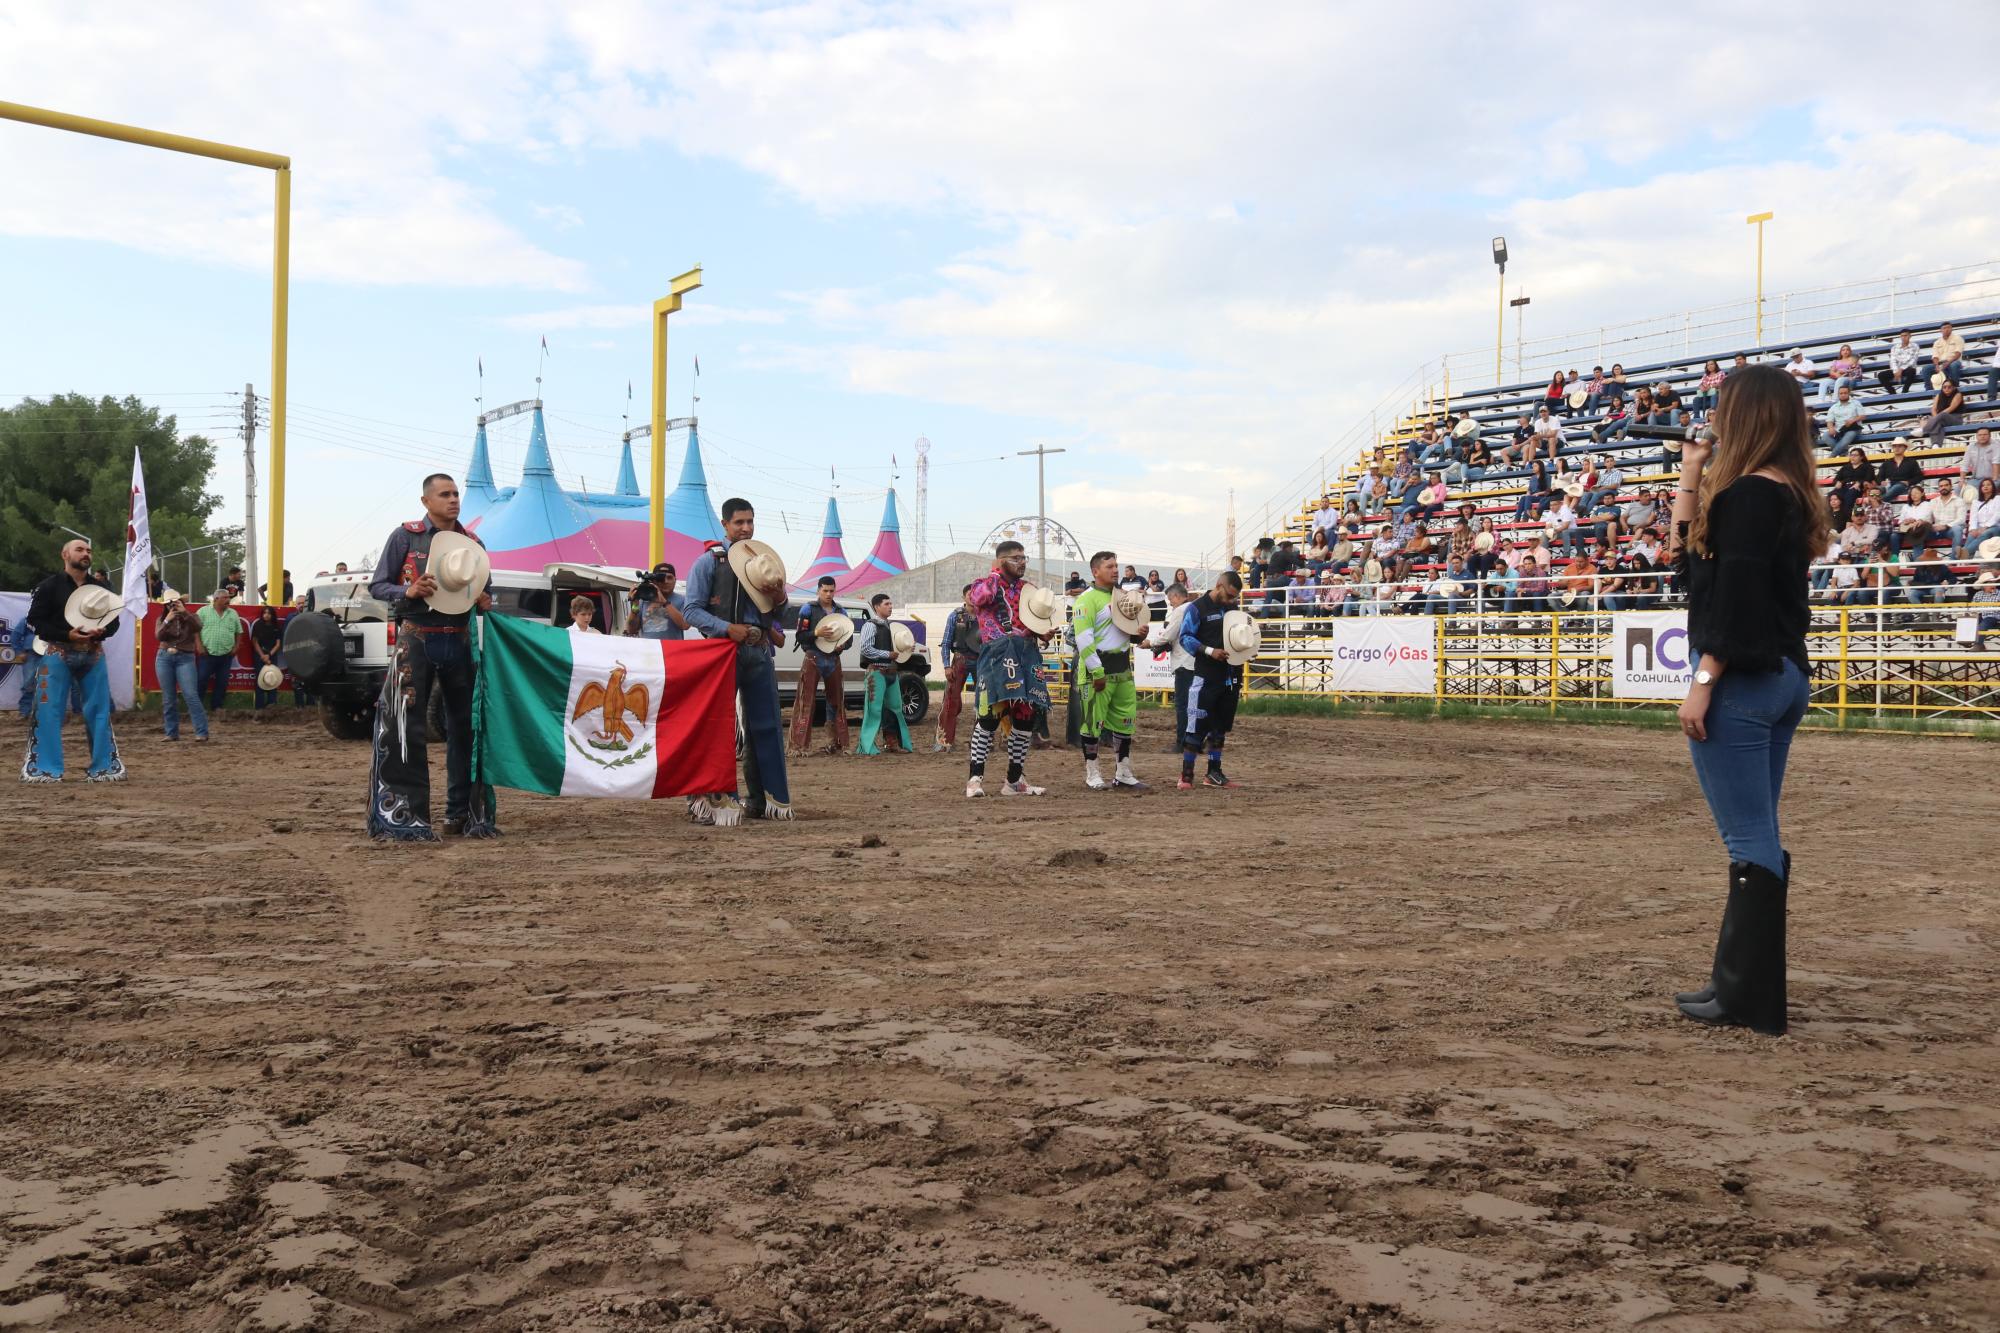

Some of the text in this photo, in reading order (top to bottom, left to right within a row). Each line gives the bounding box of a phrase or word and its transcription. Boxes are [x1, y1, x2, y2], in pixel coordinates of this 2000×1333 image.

[1338, 646, 1428, 662] Cargo Gas
[1626, 673, 1681, 683] COAHUILA
